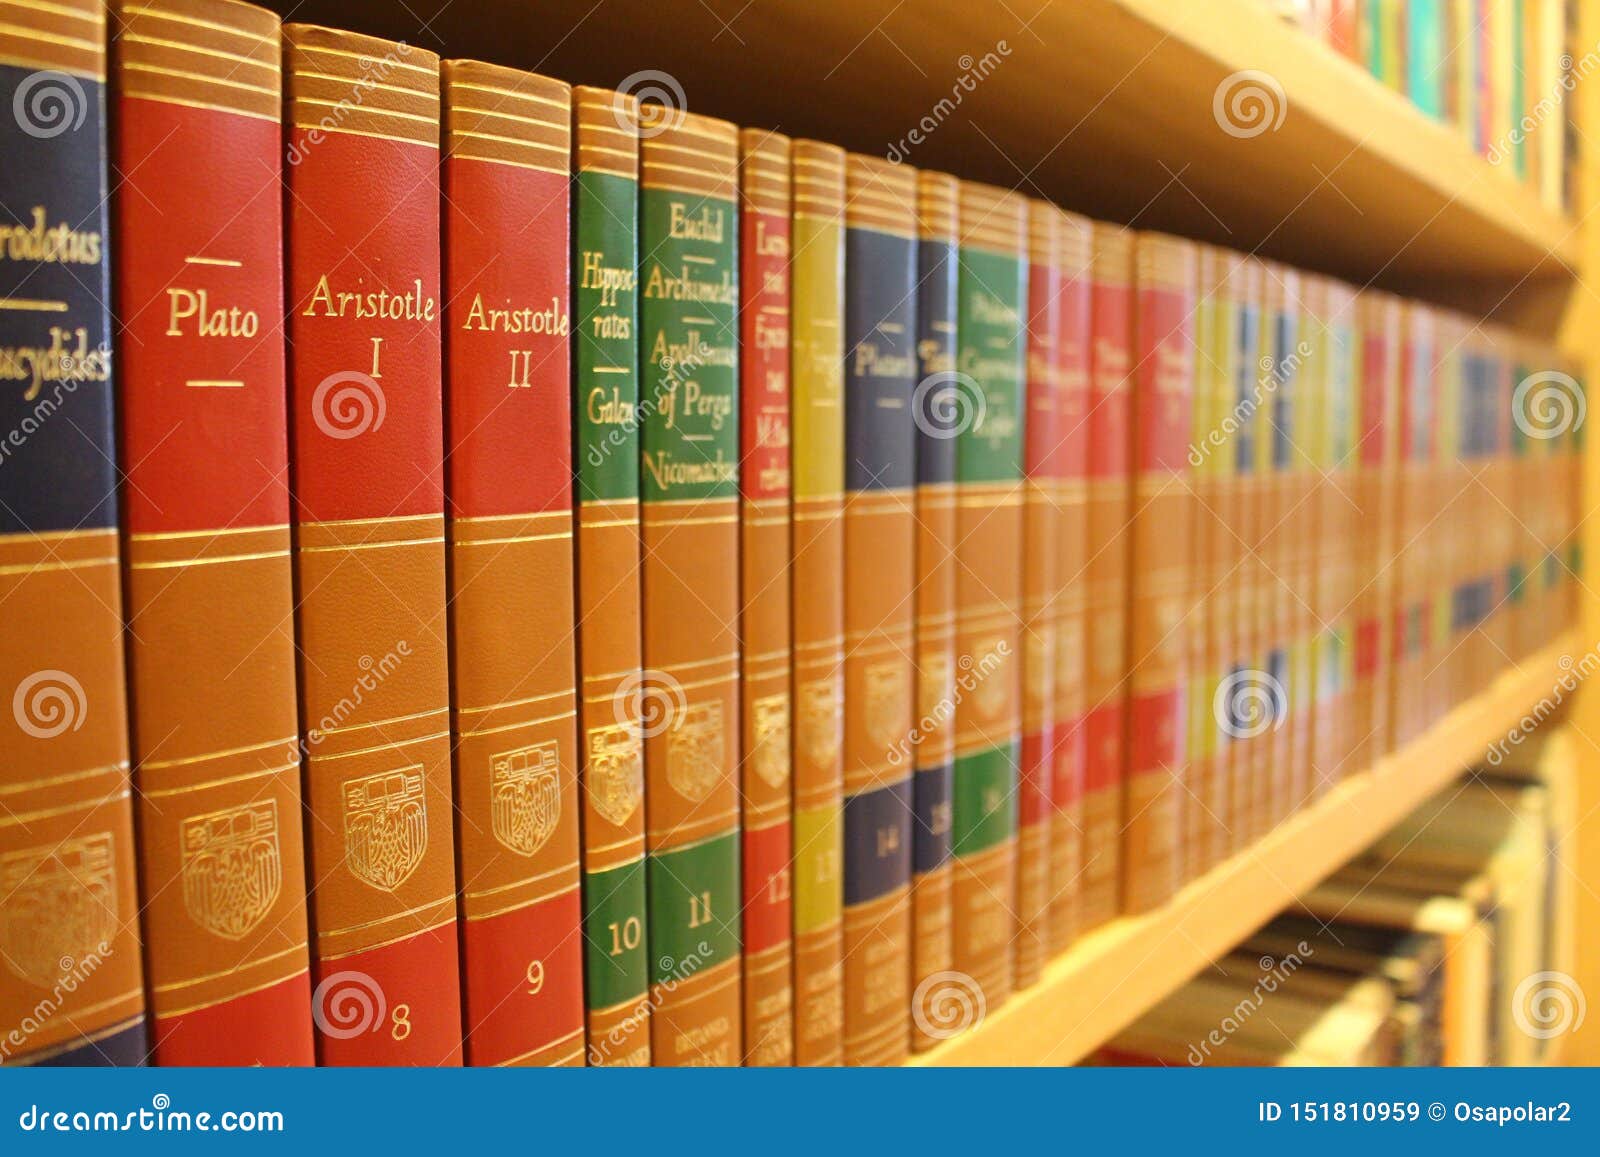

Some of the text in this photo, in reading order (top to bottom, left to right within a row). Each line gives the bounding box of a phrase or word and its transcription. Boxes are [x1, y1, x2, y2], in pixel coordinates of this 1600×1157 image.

[669, 203, 724, 244] Euclid
[166, 288, 259, 338] Plato
[302, 274, 435, 321] Aristotle
[462, 292, 570, 337] Aristotle
[592, 313, 632, 340] rates
[369, 337, 384, 378] I
[508, 350, 532, 388] II
[688, 891, 713, 929] 11
[608, 917, 641, 957] 10
[527, 960, 545, 995] 9
[391, 1004, 411, 1041] 8
